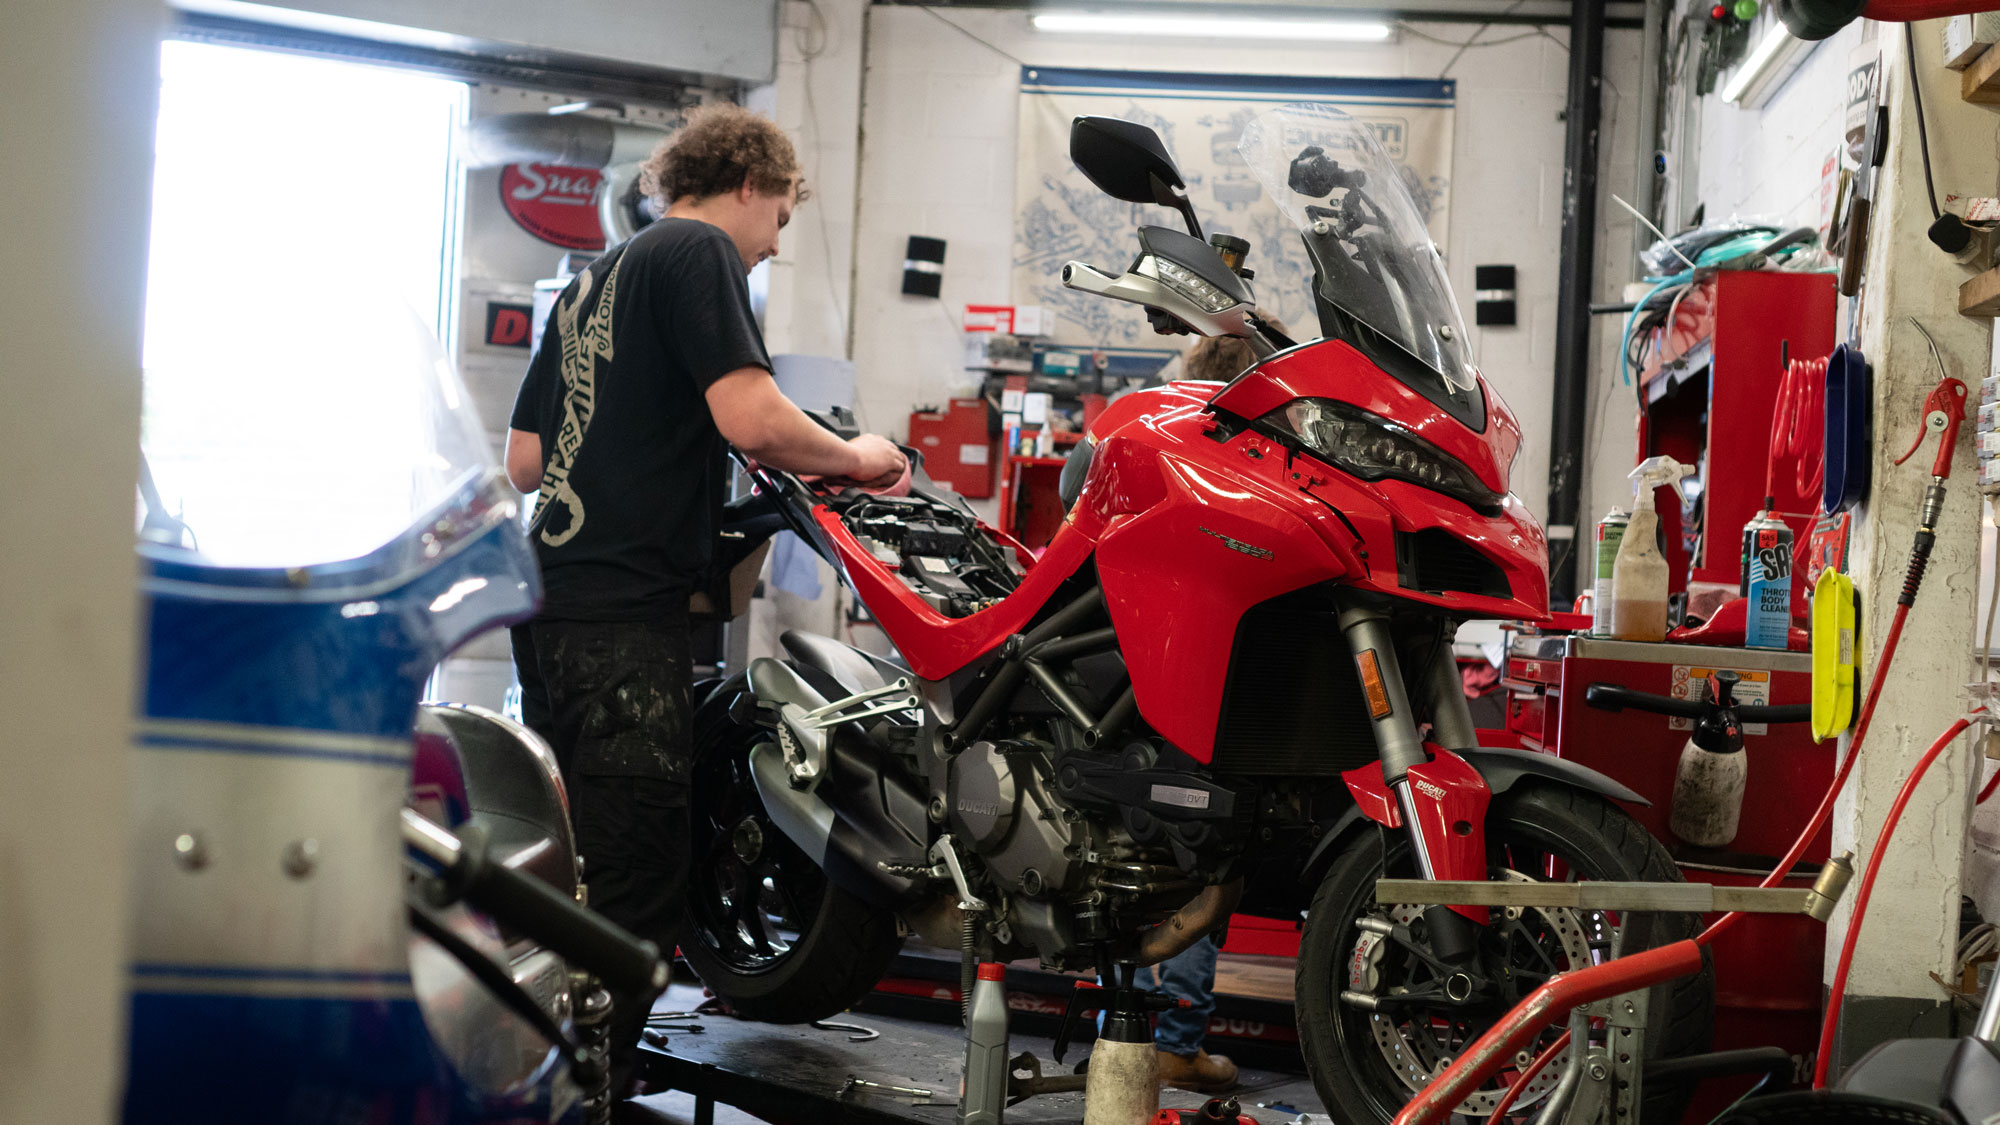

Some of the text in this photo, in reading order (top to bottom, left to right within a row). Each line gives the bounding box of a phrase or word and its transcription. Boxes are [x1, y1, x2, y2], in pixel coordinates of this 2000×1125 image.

[1761, 596, 1785, 604] BODY
[1415, 780, 1447, 797] DUCATI
[958, 799, 999, 816] DUCATI
[1352, 940, 1368, 984] brembo
